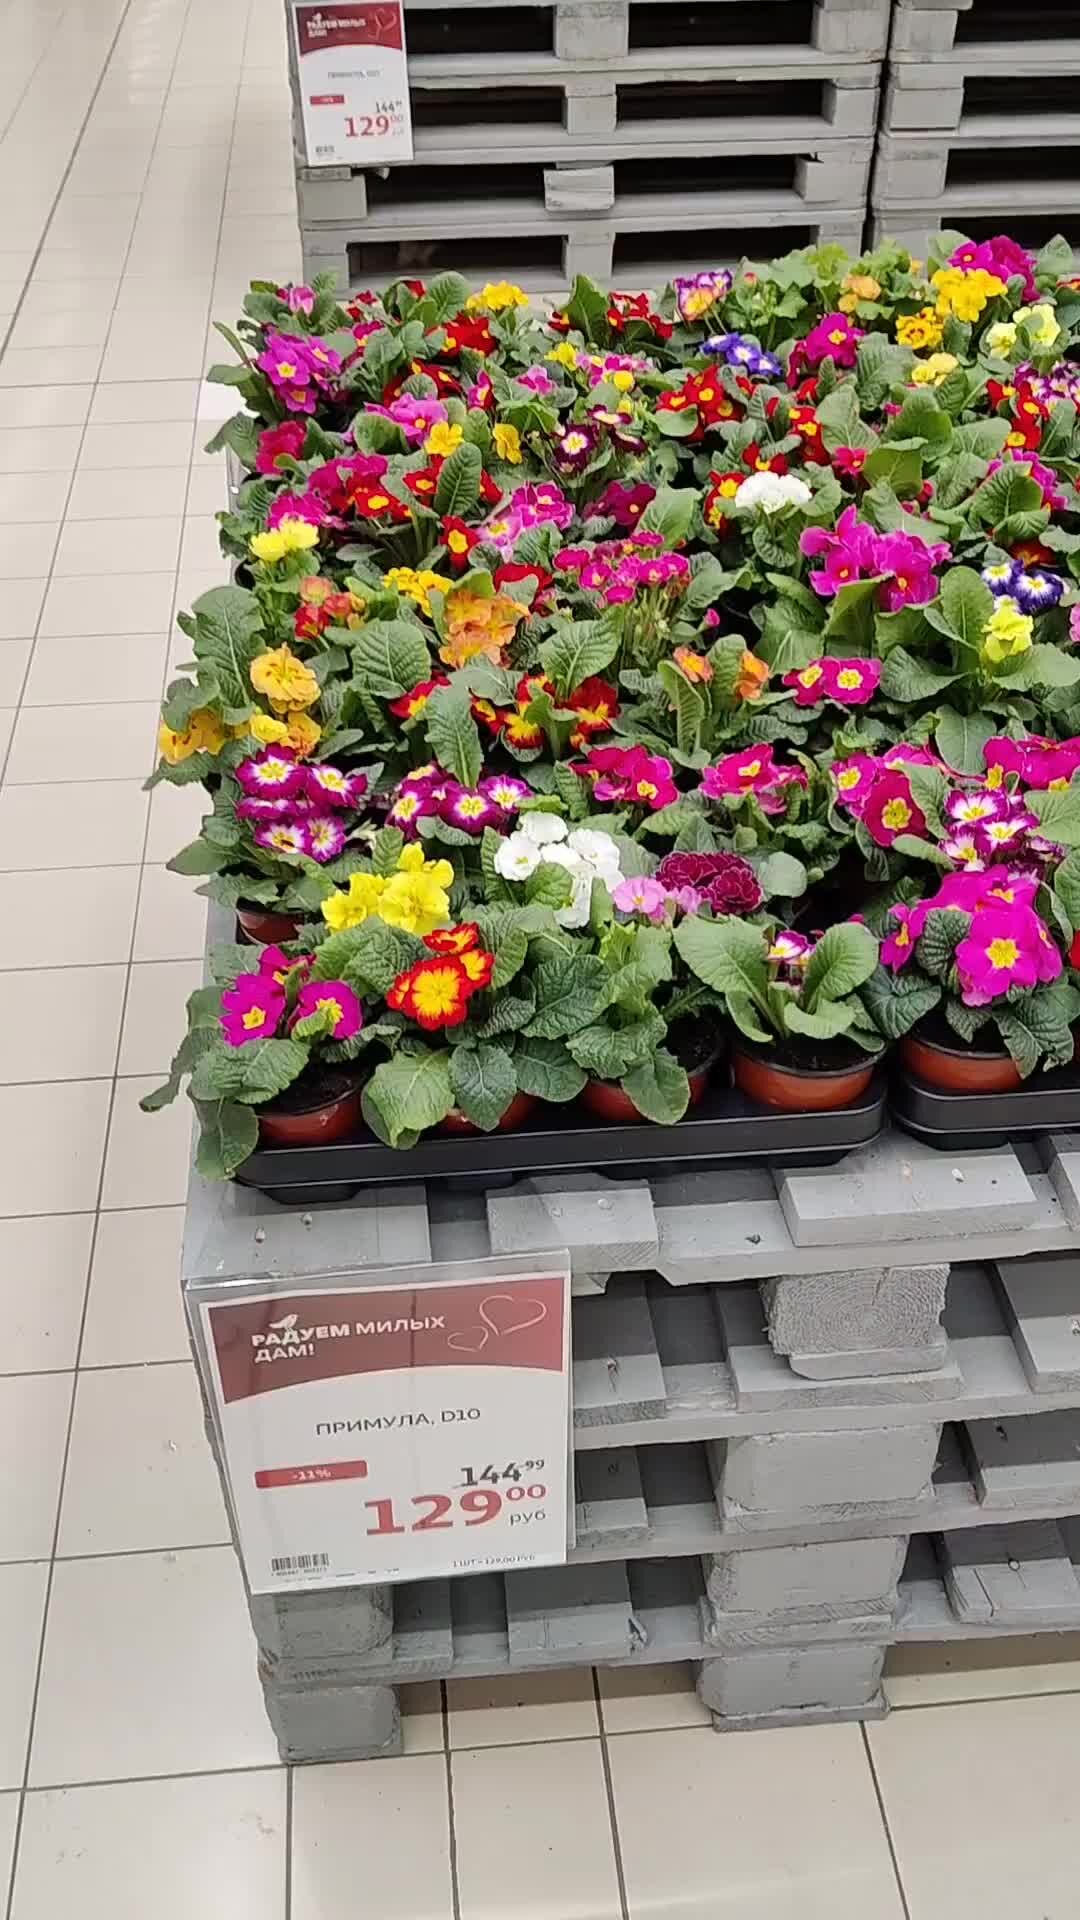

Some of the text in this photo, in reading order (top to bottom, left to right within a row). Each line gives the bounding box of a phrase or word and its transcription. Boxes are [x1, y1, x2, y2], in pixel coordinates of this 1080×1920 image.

[344, 115, 389, 137] 129
[251, 1315, 446, 1347] РАДУЕМ МИЛЫХ
[254, 1345, 316, 1363] ДАМ!
[316, 1408, 481, 1435] ПРИМУЛА, D10
[292, 1467, 331, 1480] -11%
[459, 1463, 523, 1487] 144
[364, 1489, 502, 1535] 129
[510, 1509, 546, 1526] руб
